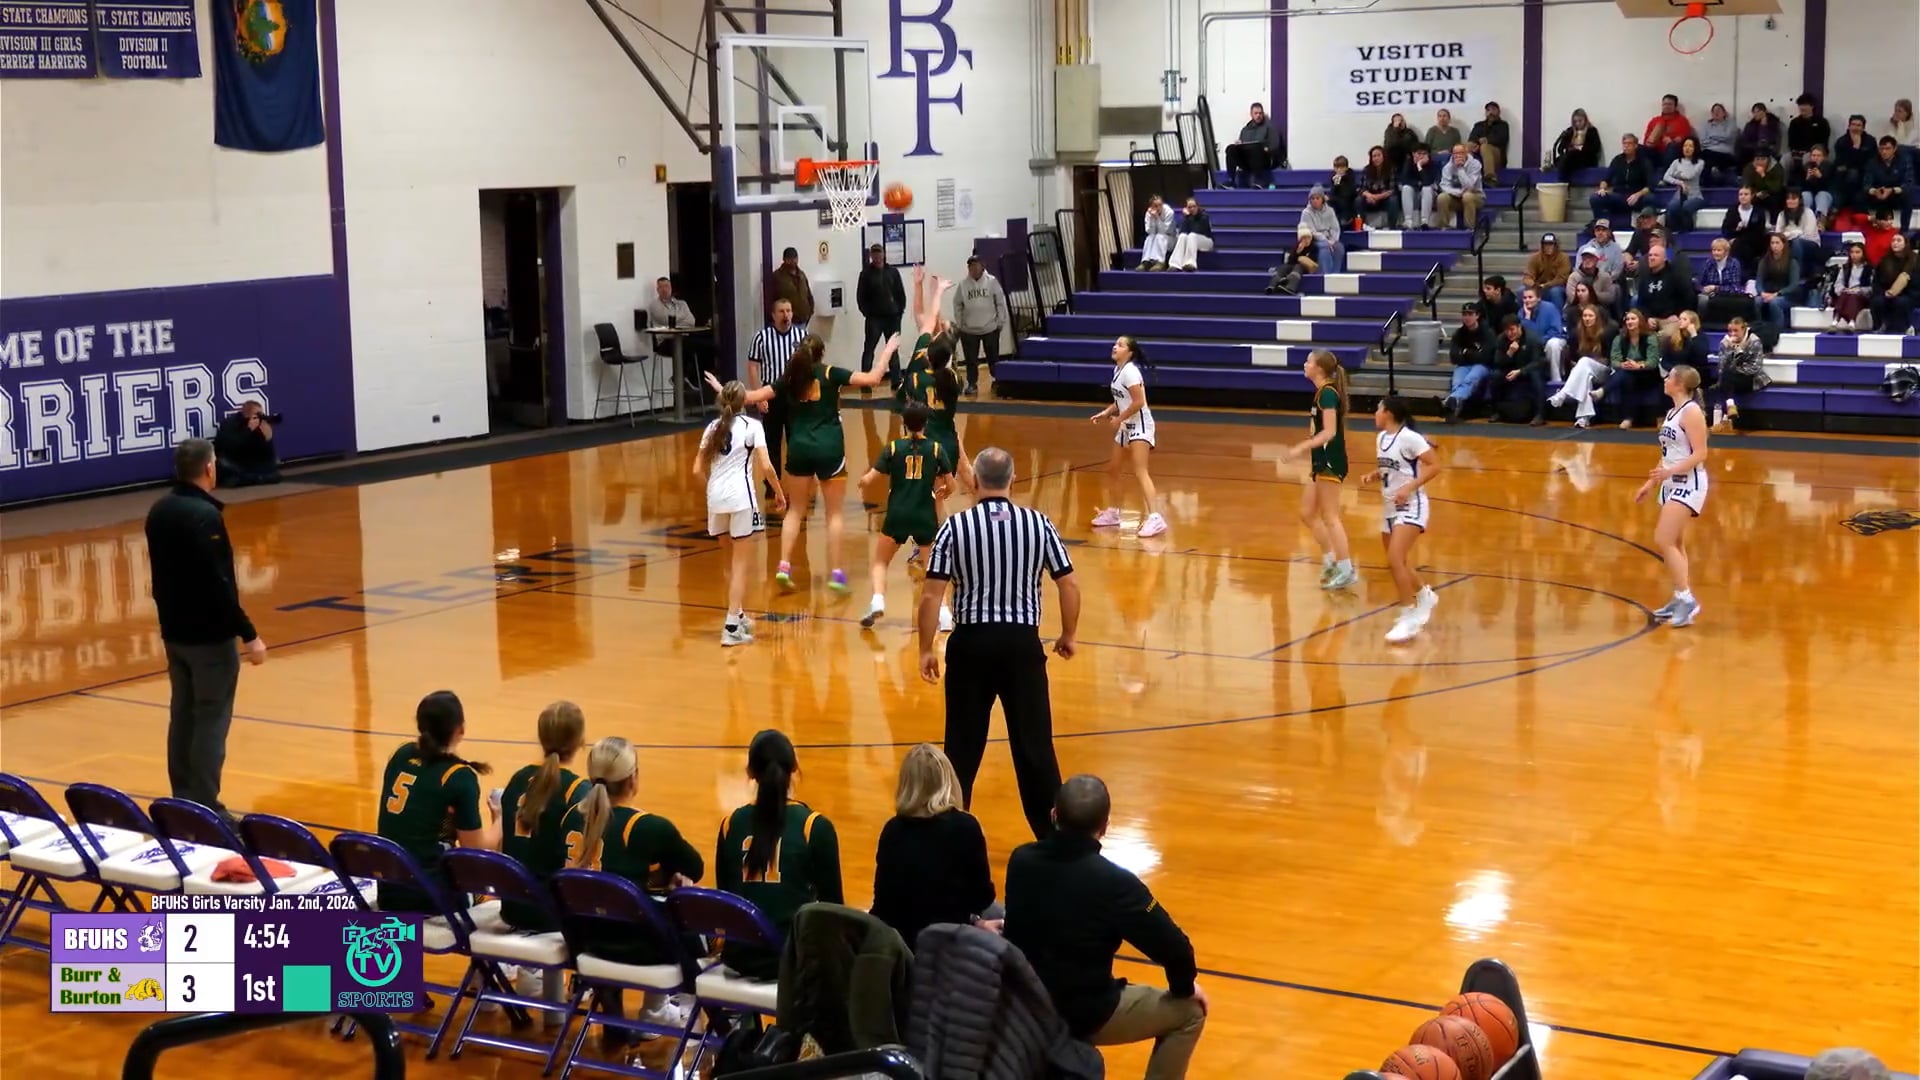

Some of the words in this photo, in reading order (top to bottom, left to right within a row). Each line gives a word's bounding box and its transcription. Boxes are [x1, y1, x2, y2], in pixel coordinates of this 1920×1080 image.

[3, 7, 33, 24] STATE
[35, 8, 88, 24] CHAMPIONS
[111, 11, 139, 26] STATE
[142, 11, 191, 26] CHAMPIONS
[0, 35, 38, 51] IVISION
[41, 36, 52, 51] III
[54, 36, 83, 52] GIRLS
[119, 37, 159, 52] DIVISION
[161, 37, 168, 52] II
[1357, 42, 1464, 61] VISITOR
[0, 54, 35, 69] ERRIER
[38, 54, 87, 70] HARRIERS
[121, 55, 168, 69] FOOTBALL
[1350, 65, 1472, 84] STUDENT
[1356, 88, 1466, 106] SECTION
[0, 331, 44, 370] ME
[54, 325, 95, 364] OF
[105, 319, 175, 358] THE
[905, 455, 924, 480] 11
[386, 771, 417, 815] 5
